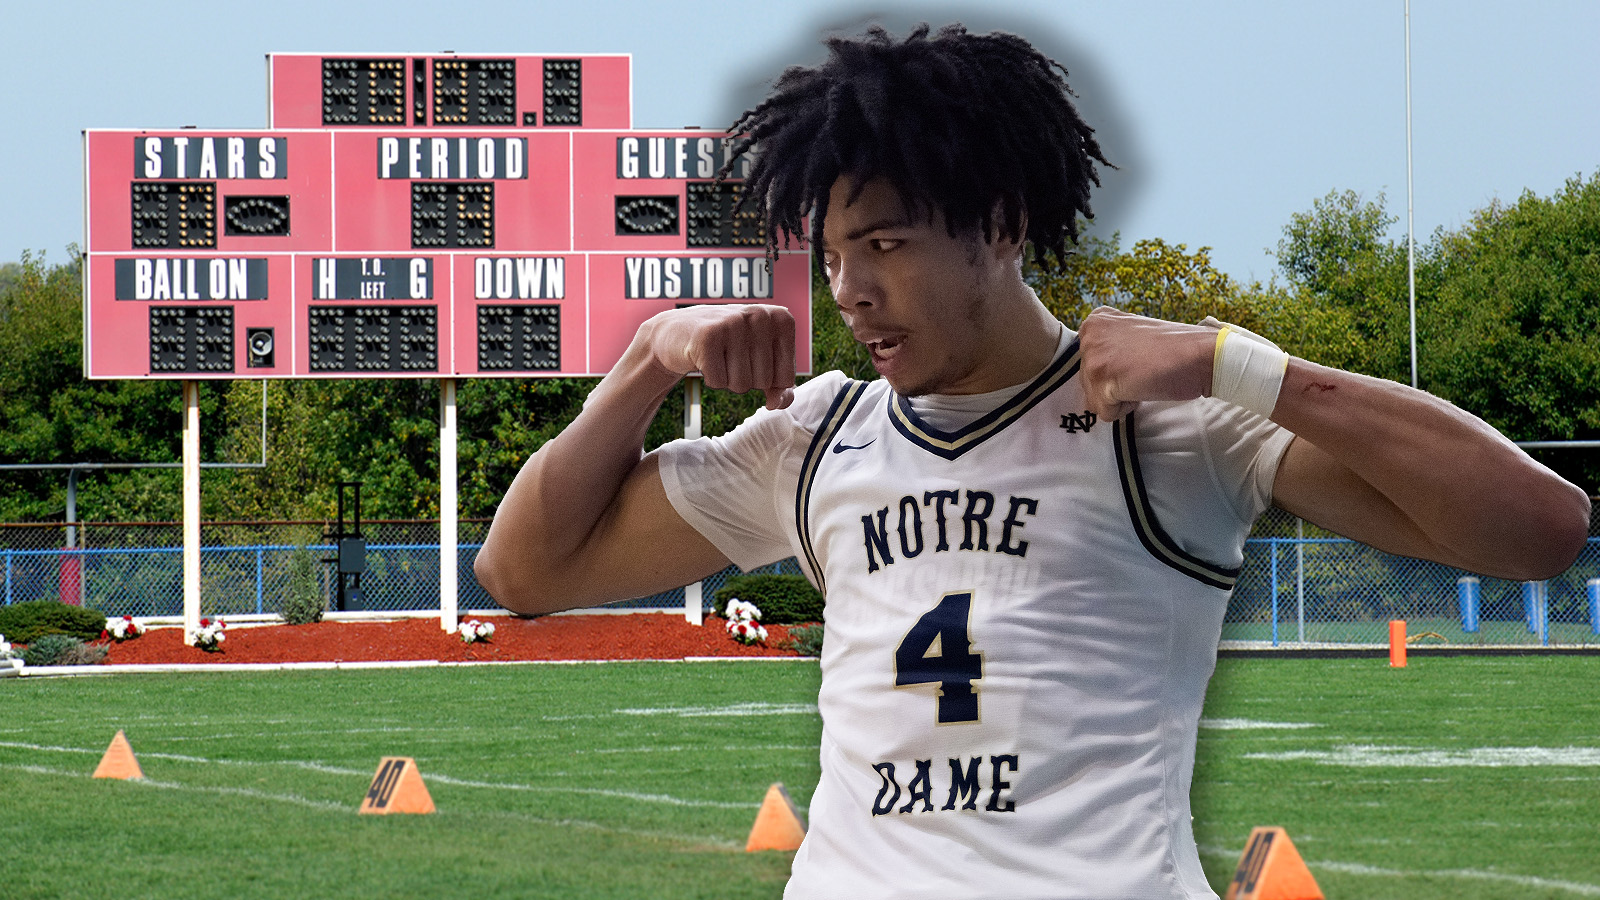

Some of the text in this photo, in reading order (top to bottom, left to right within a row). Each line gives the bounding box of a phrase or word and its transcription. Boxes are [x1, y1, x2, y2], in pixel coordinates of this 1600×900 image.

[145, 137, 275, 178] STARS
[381, 137, 522, 178] PERIOD
[136, 259, 247, 299] BALL ON
[319, 259, 336, 299] H
[361, 258, 385, 276] T.O.
[410, 259, 427, 299] G
[476, 258, 564, 298] DOWN
[626, 258, 769, 298] YDS TO GO
[361, 281, 385, 299] LEFT
[861, 488, 1039, 574] NOTRE
[893, 589, 985, 726] 4
[366, 760, 406, 808] 40
[871, 753, 1019, 817] DAME
[1235, 832, 1275, 894] 40
